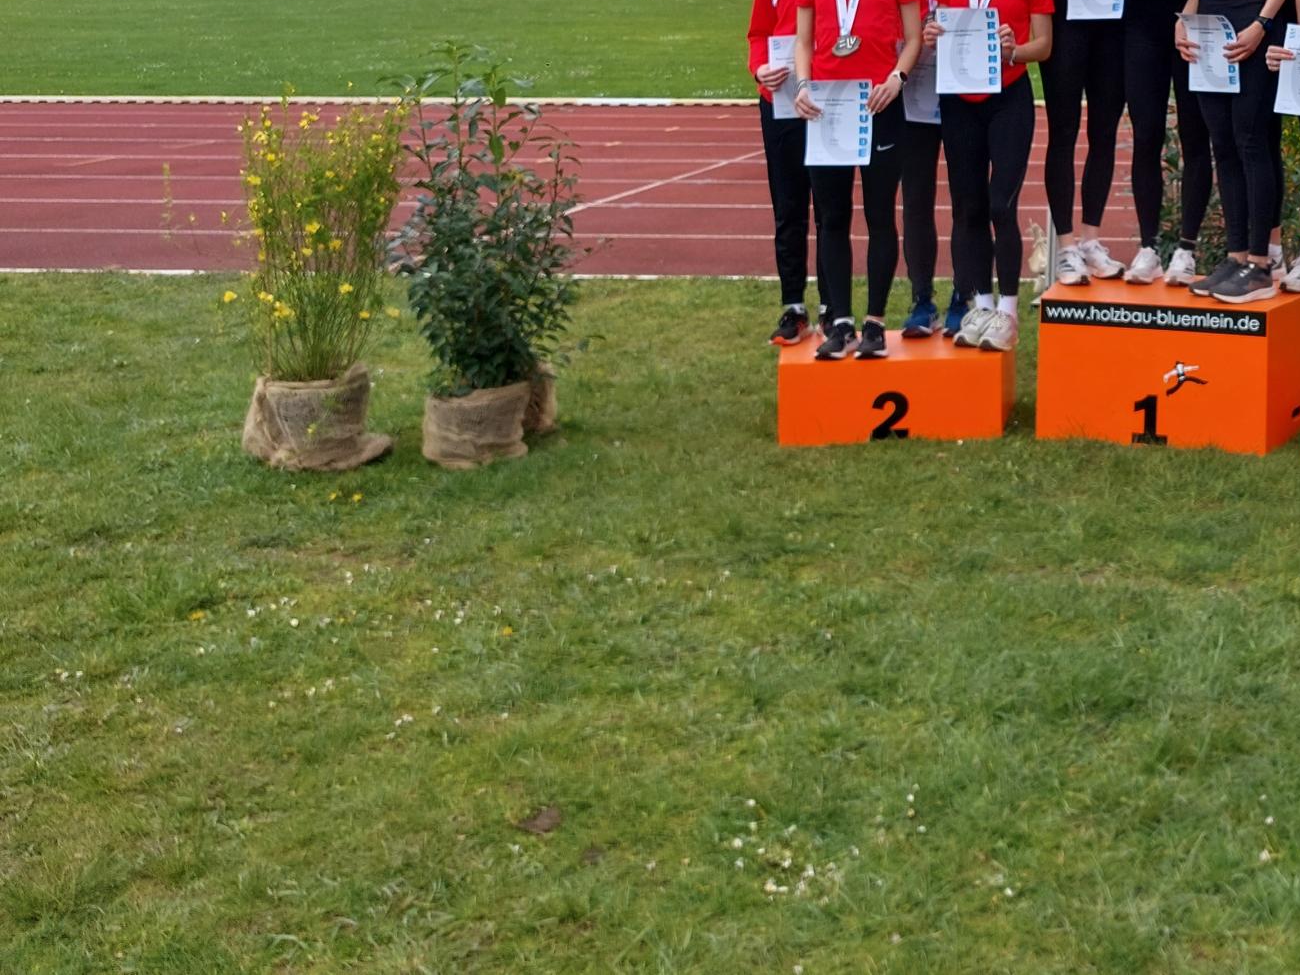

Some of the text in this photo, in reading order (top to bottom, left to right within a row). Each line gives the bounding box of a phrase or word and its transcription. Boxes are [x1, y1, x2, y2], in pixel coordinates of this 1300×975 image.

[985, 11, 997, 85] URKUNDE
[1046, 306, 1260, 331] www.holzbau-bluemlein.de
[872, 391, 909, 440] 2
[1131, 394, 1168, 445] 1
